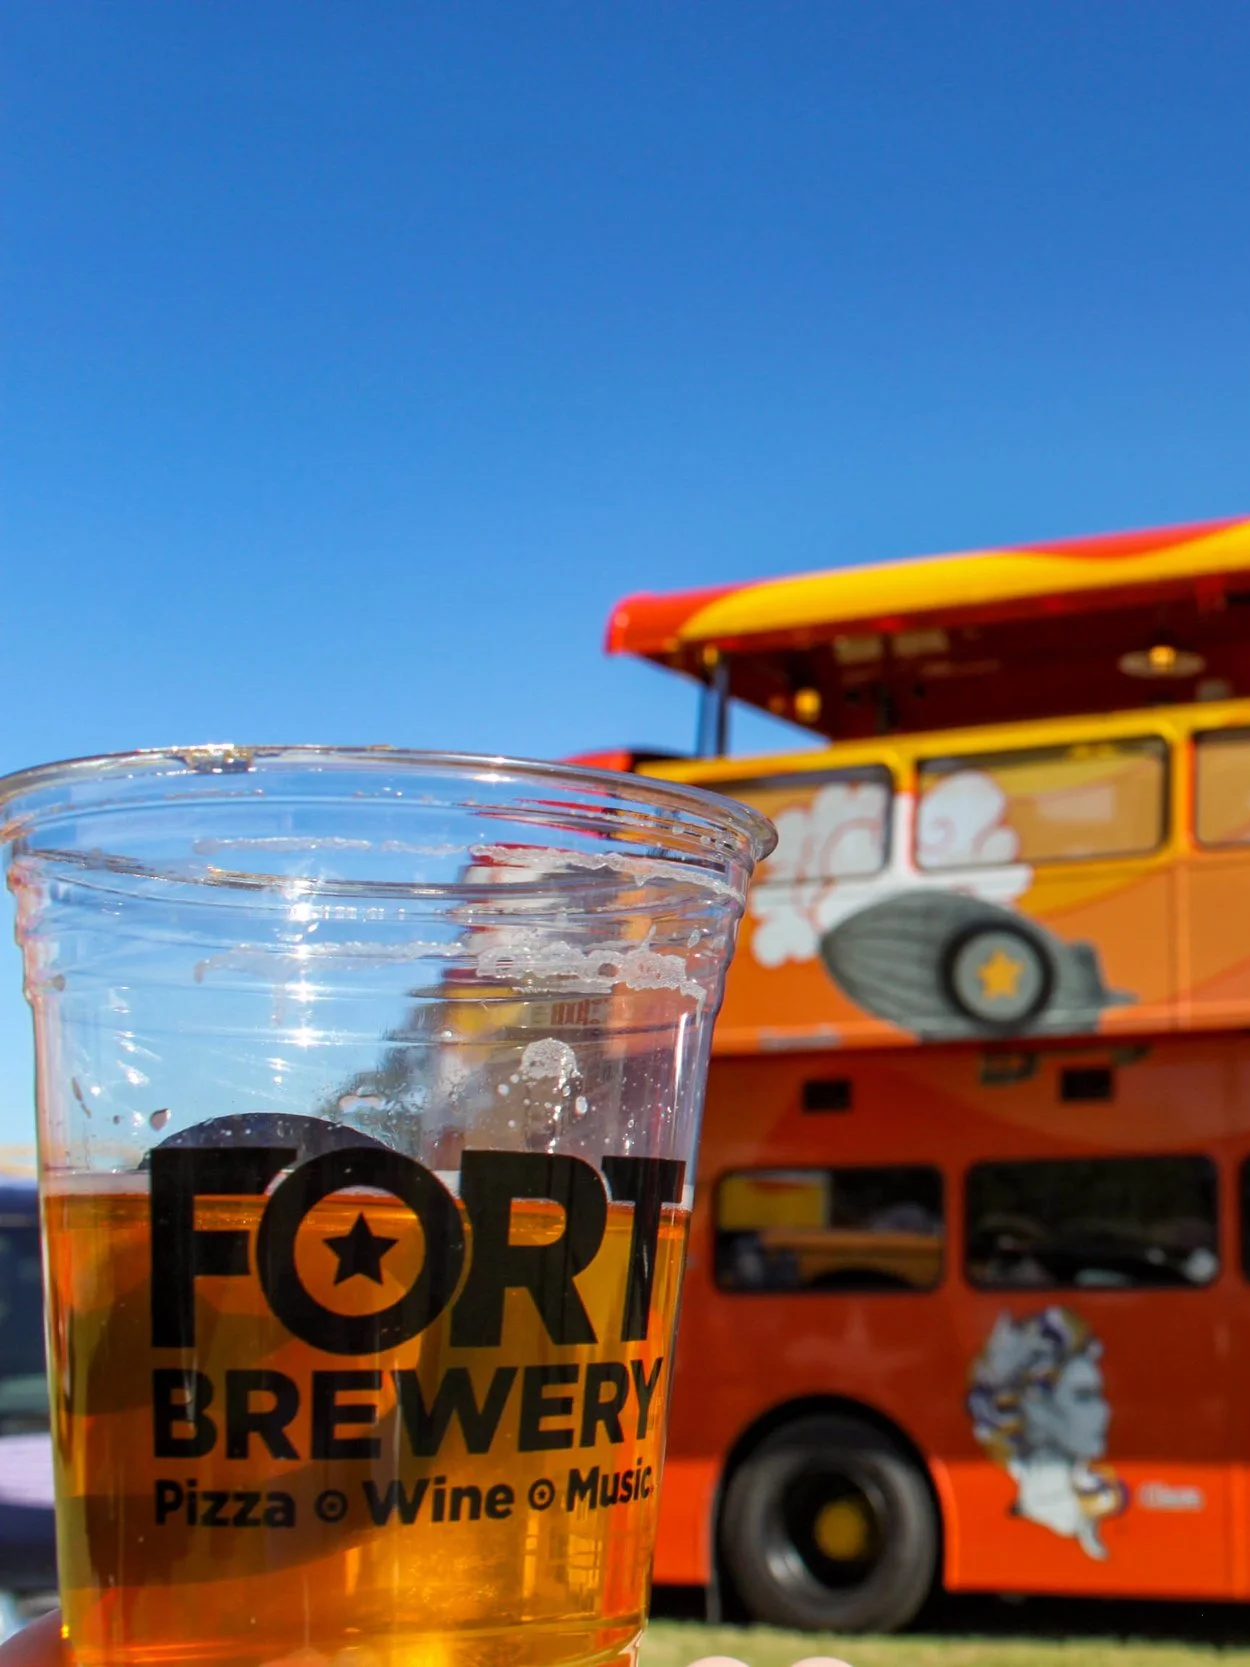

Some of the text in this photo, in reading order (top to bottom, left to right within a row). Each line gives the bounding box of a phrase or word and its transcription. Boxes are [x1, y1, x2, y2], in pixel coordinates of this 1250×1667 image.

[150, 1147, 687, 1356] FORT
[152, 1357, 663, 1460] BREWERY
[155, 1478, 295, 1528] Pizza
[361, 1477, 514, 1526] Wine
